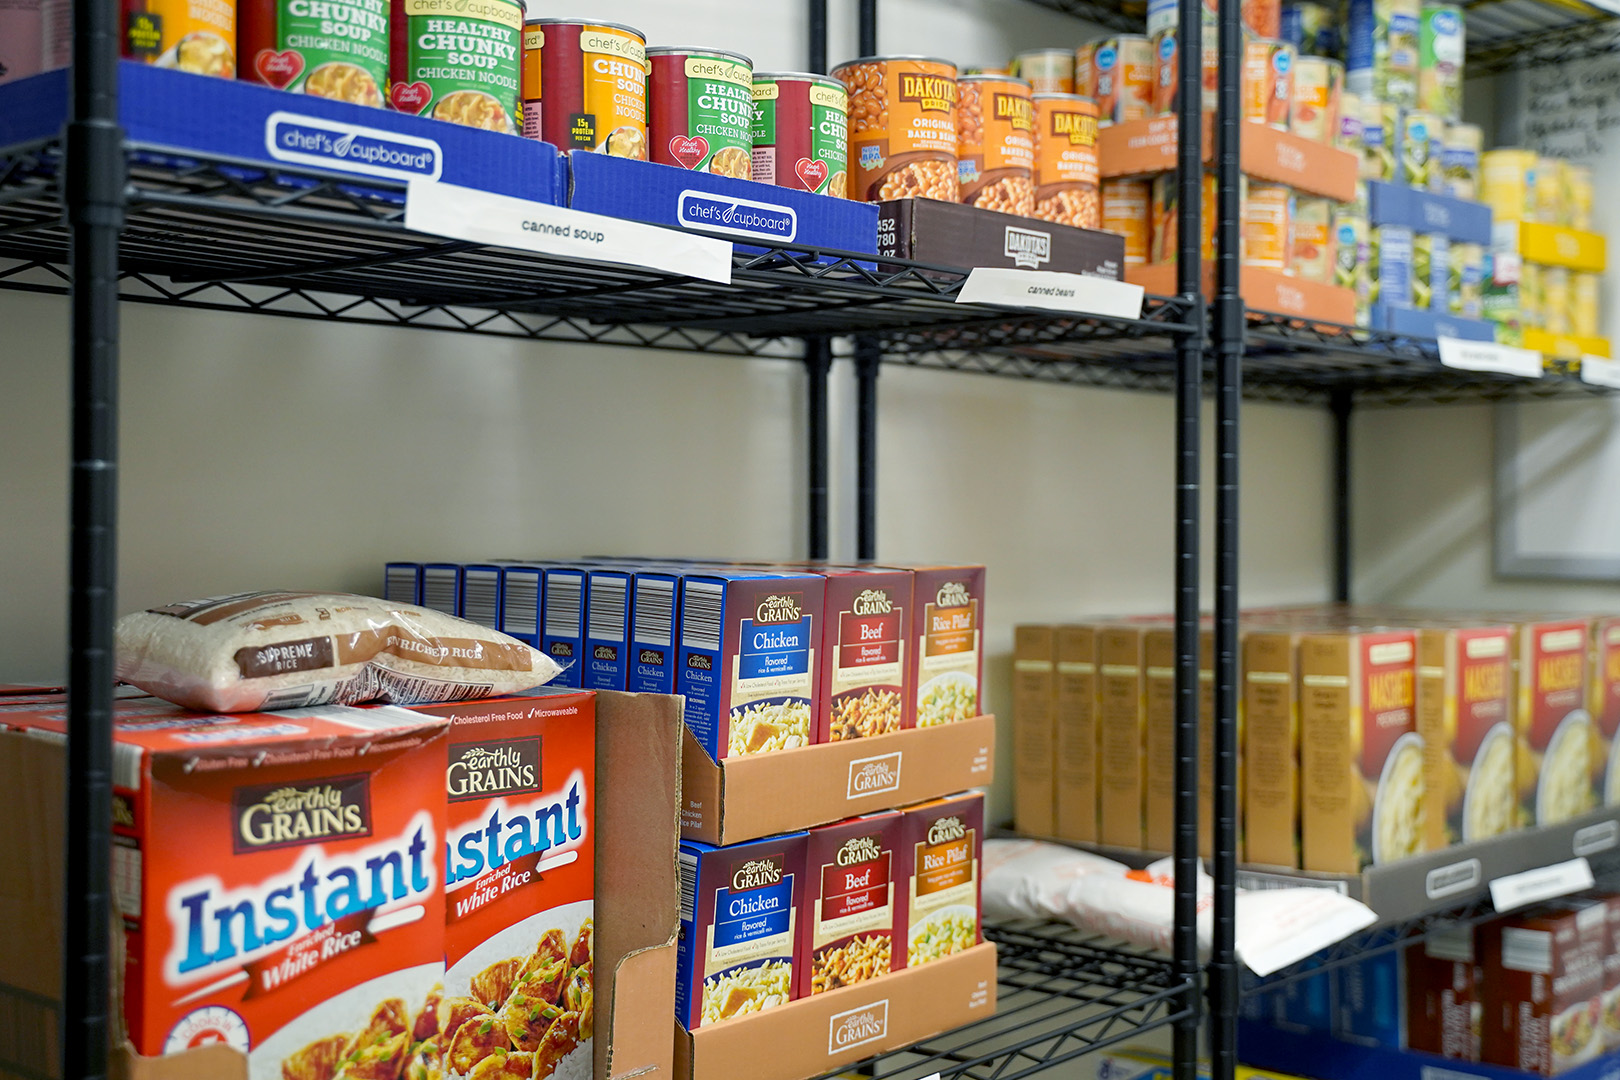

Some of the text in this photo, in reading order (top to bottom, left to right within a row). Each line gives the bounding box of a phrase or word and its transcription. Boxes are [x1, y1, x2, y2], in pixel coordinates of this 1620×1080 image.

[289, 1, 387, 34] CHUNKY
[321, 21, 372, 41] SOUP
[427, 20, 511, 42] HEALTHY
[287, 35, 350, 53] CHICKEN
[418, 34, 516, 61] CHUNKY
[588, 37, 620, 51] chef's
[448, 52, 498, 69] SOUP
[417, 67, 476, 80] CHICKEN
[478, 72, 517, 90] NOODLE
[692, 64, 723, 76] chef's
[617, 78, 644, 97] SOUP
[720, 113, 750, 129] SOUP
[912, 118, 955, 132] ORIGINAL
[571, 127, 594, 135] PROTEIN
[696, 124, 739, 138] CHICKEN
[907, 130, 937, 140] BAKED
[283, 130, 333, 153] chef's
[862, 152, 881, 161] BPA
[689, 203, 721, 220] chef's
[522, 220, 605, 243] canned soup
[1028, 286, 1075, 297] canned beans
[768, 596, 794, 608] earthly
[853, 596, 891, 615] GRAINS
[937, 588, 970, 607] GRAINS
[757, 602, 800, 623] GRAINS
[932, 612, 971, 631] Rice Pilaf
[753, 631, 799, 649] Chicken
[860, 622, 884, 640] Beef
[257, 643, 313, 664] SUPREME
[386, 635, 482, 660] ENRICHED RICE
[594, 648, 617, 660] GRAINS
[861, 645, 882, 656] flavored
[276, 659, 298, 670] RICE
[591, 660, 618, 673] Chicken
[640, 653, 663, 665] GRAINS
[688, 657, 711, 669] GRAINS
[764, 655, 788, 666] flavored
[637, 665, 664, 678] Chicken
[685, 669, 713, 682] Chicken
[453, 711, 524, 725] Cholesterol Free Food
[534, 706, 579, 718] Microwaveable
[228, 757, 248, 768] Free
[265, 747, 355, 764] Cholesterol Free Food
[467, 747, 521, 771] earthly
[446, 762, 535, 796] GRAINS
[854, 771, 894, 791] GRAINS
[271, 785, 342, 814] earthly
[681, 809, 702, 819] Chicken
[240, 804, 362, 845] GRAINS
[445, 781, 581, 886] stant
[928, 825, 965, 845] GRAINS
[837, 846, 880, 866] GRAINS
[923, 843, 968, 870] Rice Pilaf
[745, 859, 774, 875] earthly
[475, 863, 511, 891] Enriched
[733, 869, 780, 890] GRAINS
[845, 868, 871, 890] Beef
[178, 824, 429, 974] Instant
[456, 869, 531, 917] White Rice
[846, 891, 869, 905] flavored
[729, 895, 779, 917] Chicken
[741, 917, 767, 931] flavored
[288, 922, 336, 957] Enriched
[261, 930, 362, 991] White Rice
[847, 1012, 874, 1029] earthly
[835, 1020, 881, 1045] GRAINS
